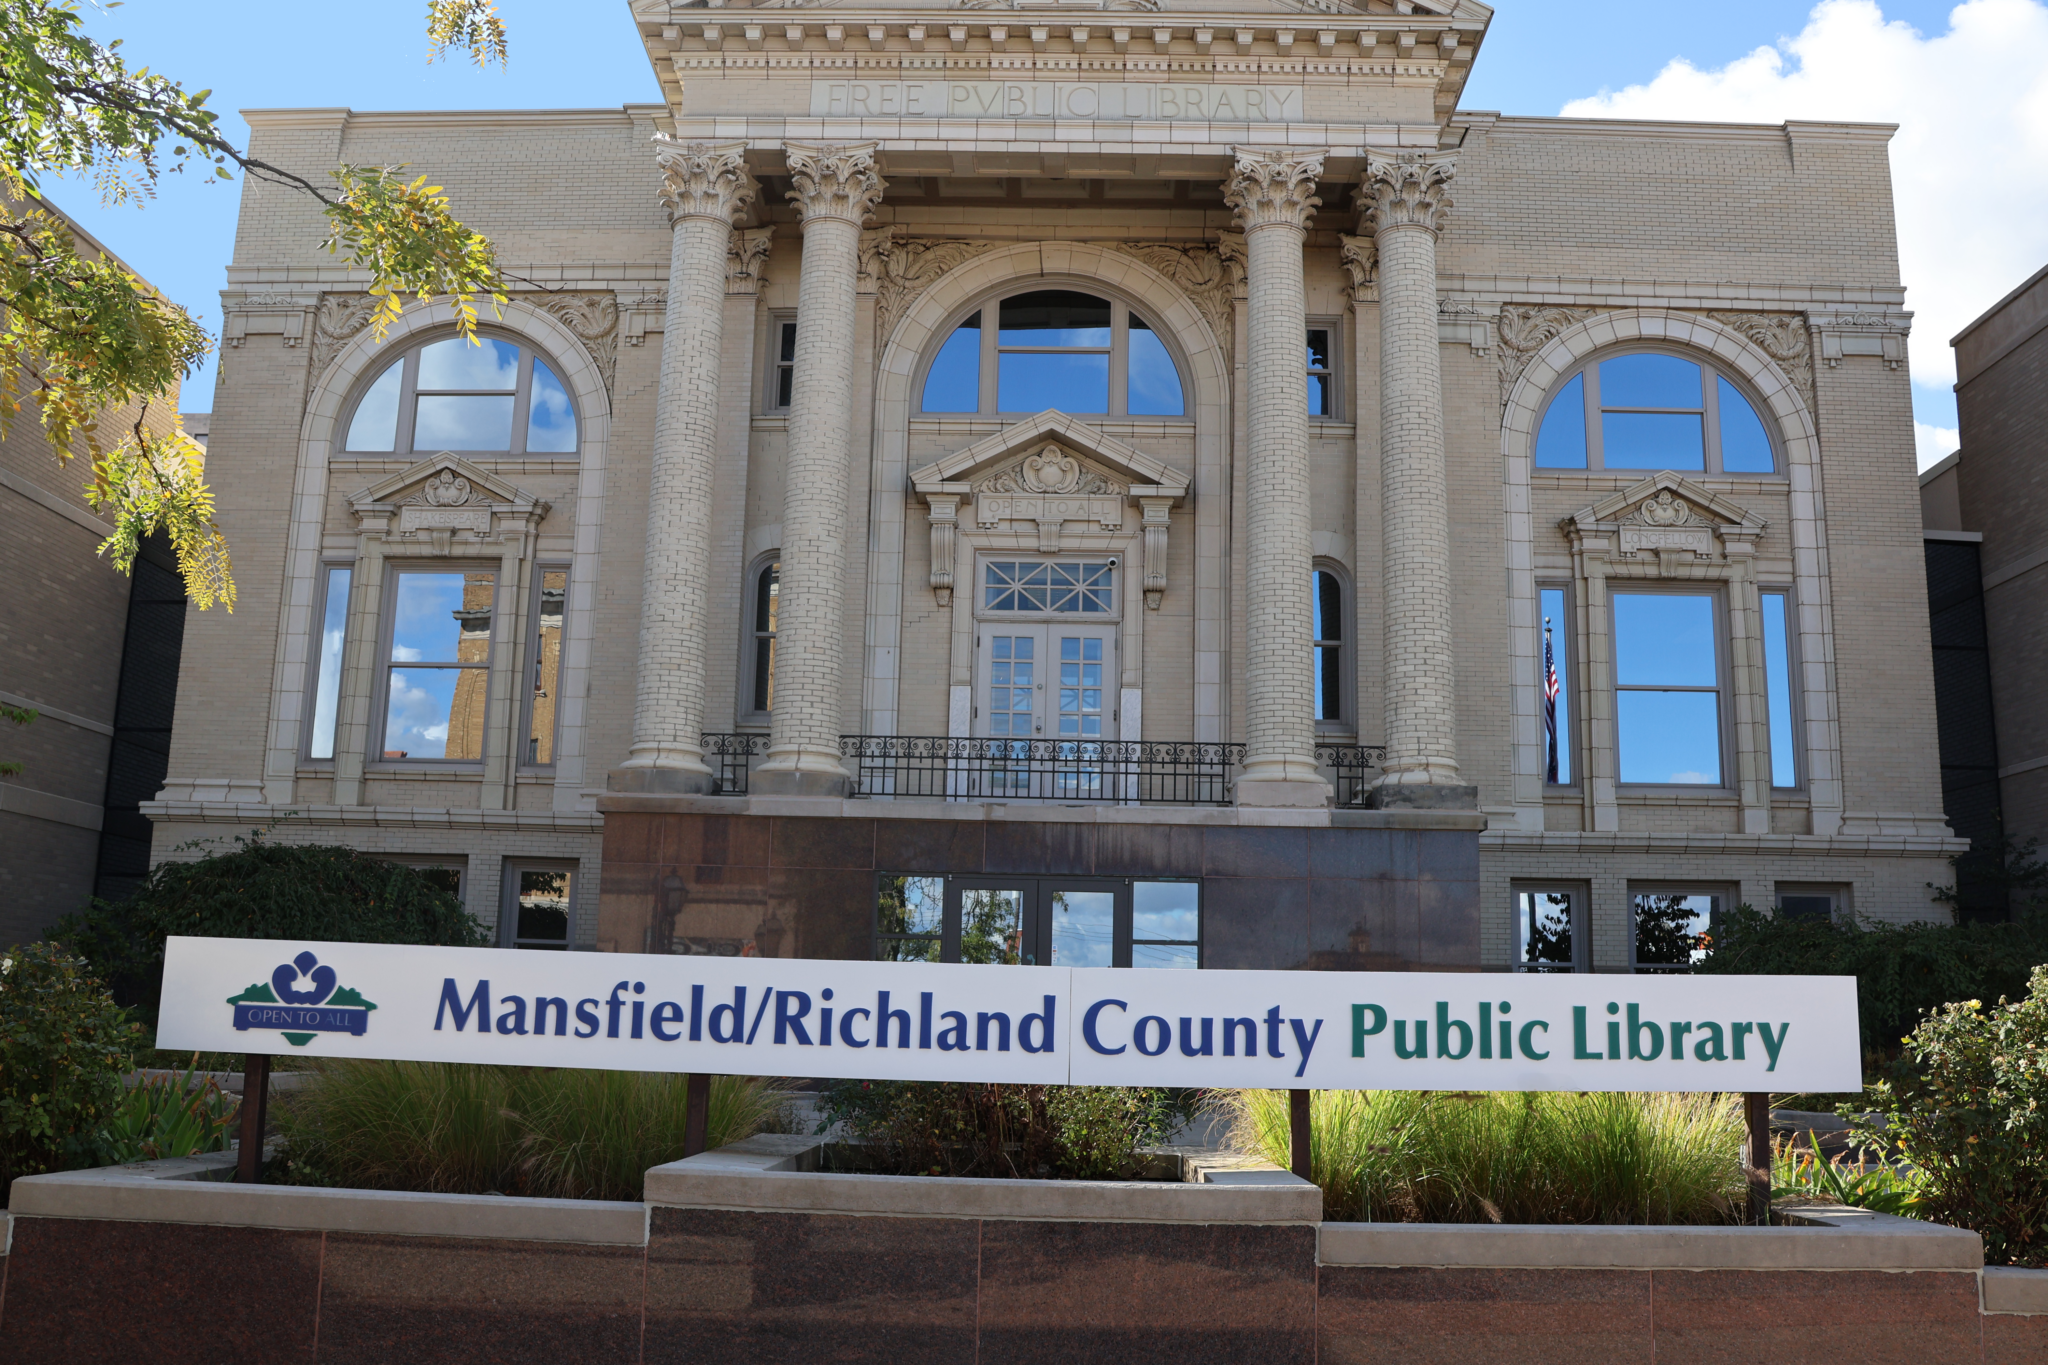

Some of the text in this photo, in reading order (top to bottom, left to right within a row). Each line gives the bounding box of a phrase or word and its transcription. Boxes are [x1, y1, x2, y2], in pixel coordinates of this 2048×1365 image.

[826, 84, 1295, 121] FREE PVBLIC LIBRARY
[988, 500, 1111, 515] OPEN TO ALL
[406, 512, 487, 524] SHAKESPEARE
[1624, 532, 1706, 545] LONGFELLOW
[248, 1008, 352, 1027] OPEN TO ALL
[433, 978, 1791, 1078] Mansfield/Richland County Public Library
